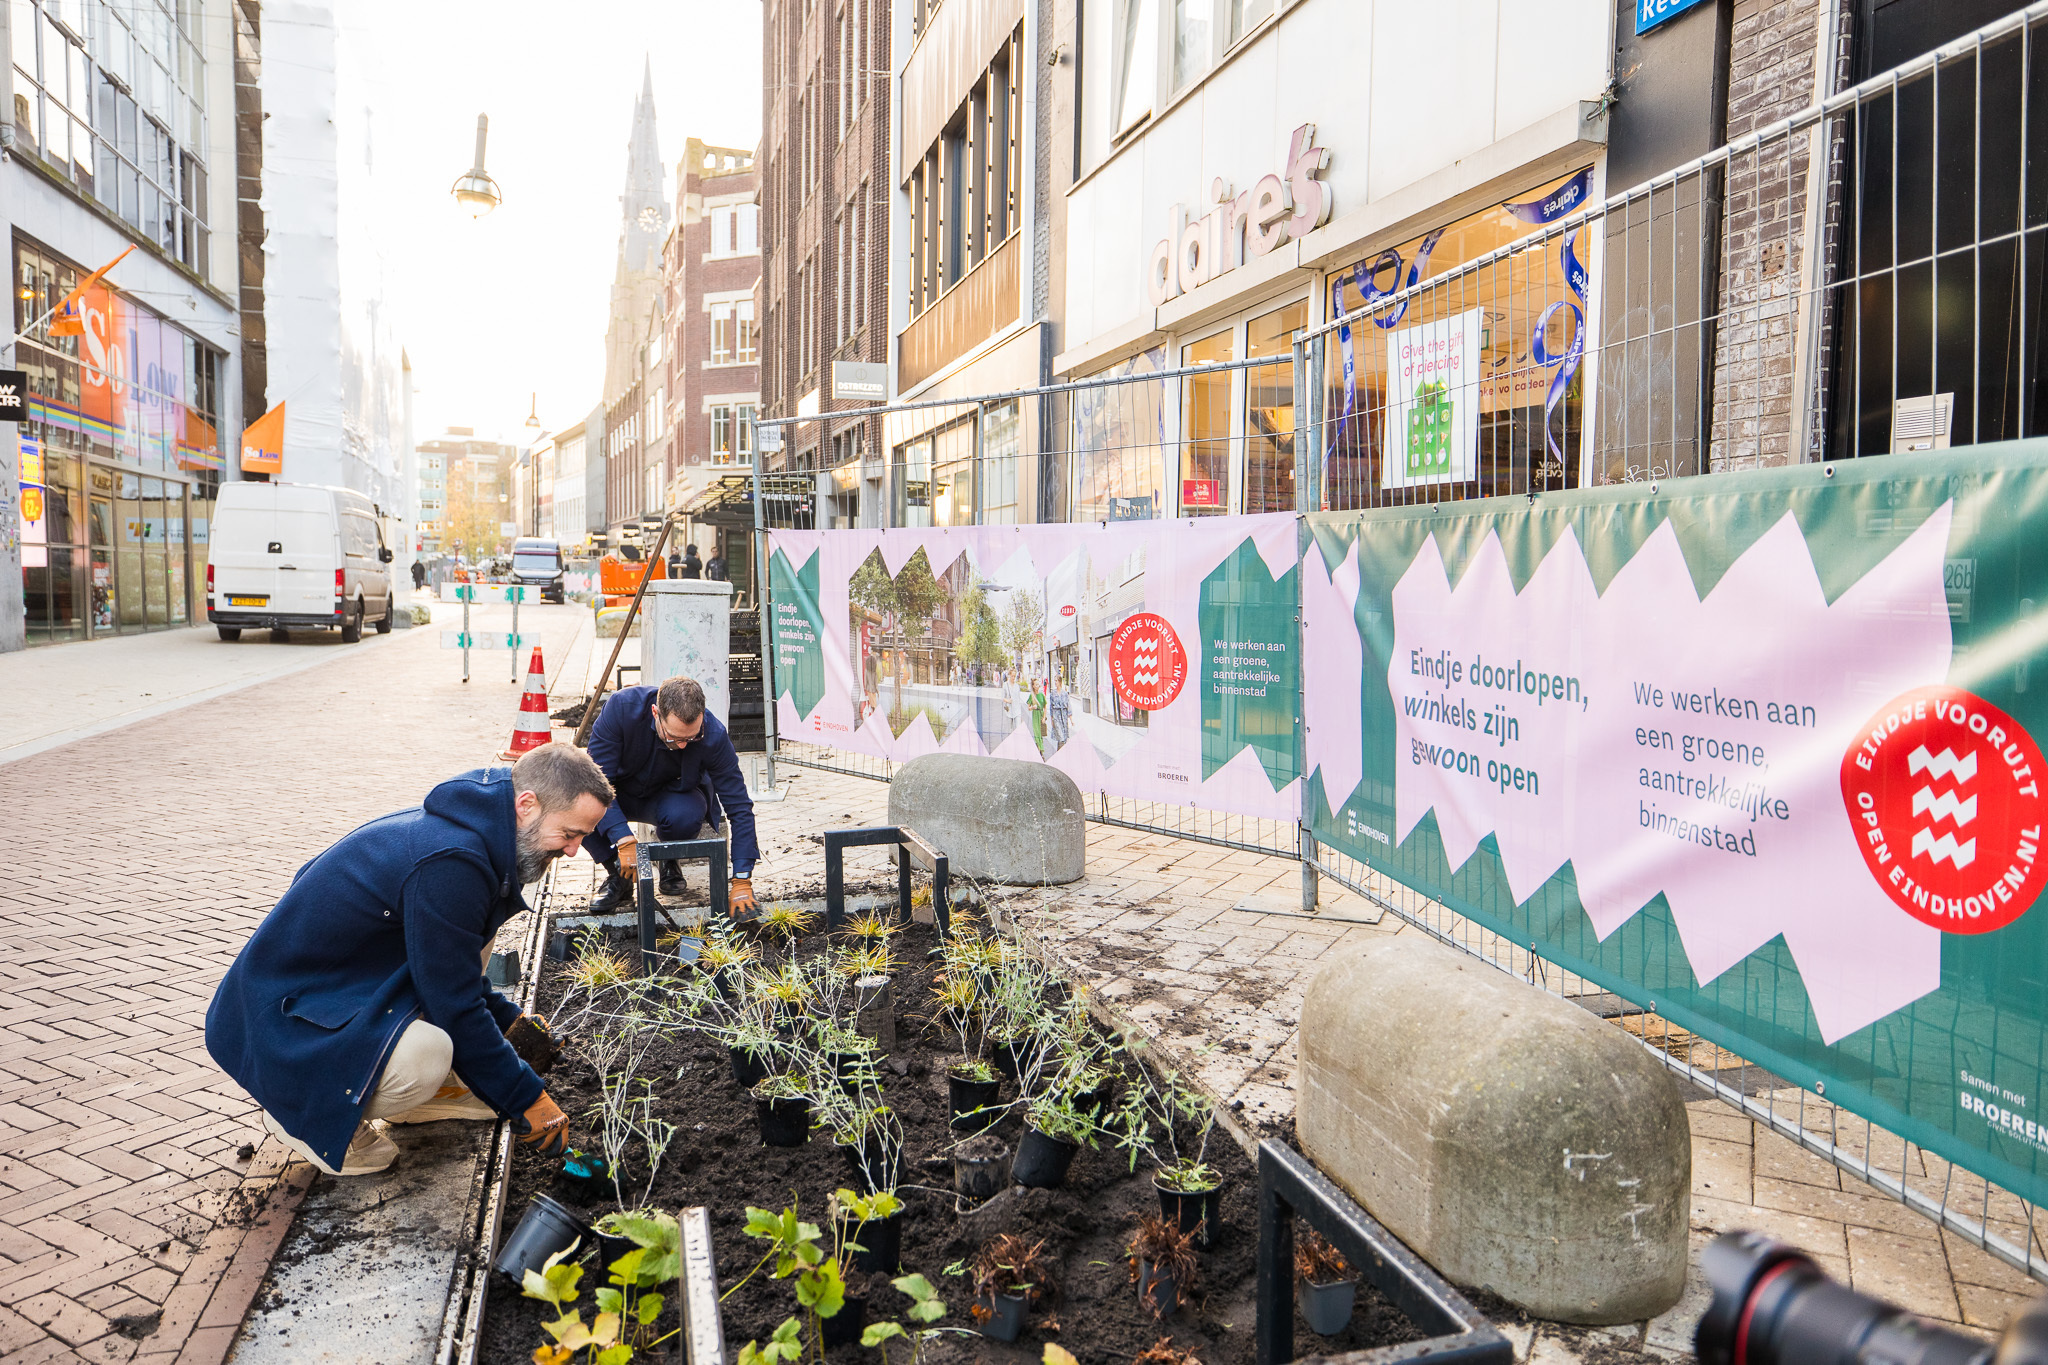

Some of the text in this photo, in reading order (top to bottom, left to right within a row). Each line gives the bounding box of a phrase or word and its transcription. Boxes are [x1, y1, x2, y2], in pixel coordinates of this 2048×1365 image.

[1148, 123, 1331, 307] claire's
[1401, 331, 1464, 359] Give the gift
[1404, 354, 1459, 377] of piercing
[837, 382, 884, 392] DSTREZZED
[778, 603, 797, 616] Eindje
[778, 616, 812, 629] doorlopen,
[778, 630, 815, 643] winkels zijn
[779, 643, 804, 653] gewoon
[1115, 620, 1143, 651] EINDJE
[1145, 618, 1179, 654] VOORUIT
[1213, 639, 1286, 651] We werken aan
[780, 656, 796, 666] open
[1213, 655, 1270, 668] een groene,
[1114, 660, 1182, 705] OPEN EINDHOVEN.NL
[1213, 670, 1280, 685] aantrekkelijke
[1213, 682, 1266, 697] binnenstad
[1411, 647, 1588, 712] Eindje doorlopen,
[1404, 690, 1519, 747] winkels zijn
[1634, 681, 1816, 728] We werken aan
[1635, 727, 1769, 775] een groene,
[1855, 699, 2038, 798] EINDJE VOORUIT
[1157, 772, 1189, 782] BROEREN
[1411, 737, 1539, 795] gewoon open
[1639, 767, 1790, 823] aantrekkelijke
[1358, 822, 1389, 846] EINDHOVEN
[1639, 799, 1757, 857] binnenstad
[1857, 792, 2041, 920] OPEN EINDHOVEN.NL
[1960, 1070, 2026, 1107] Samen met
[1960, 1091, 2048, 1146] BROEREN
[1987, 1120, 2006, 1134] CIVIL
